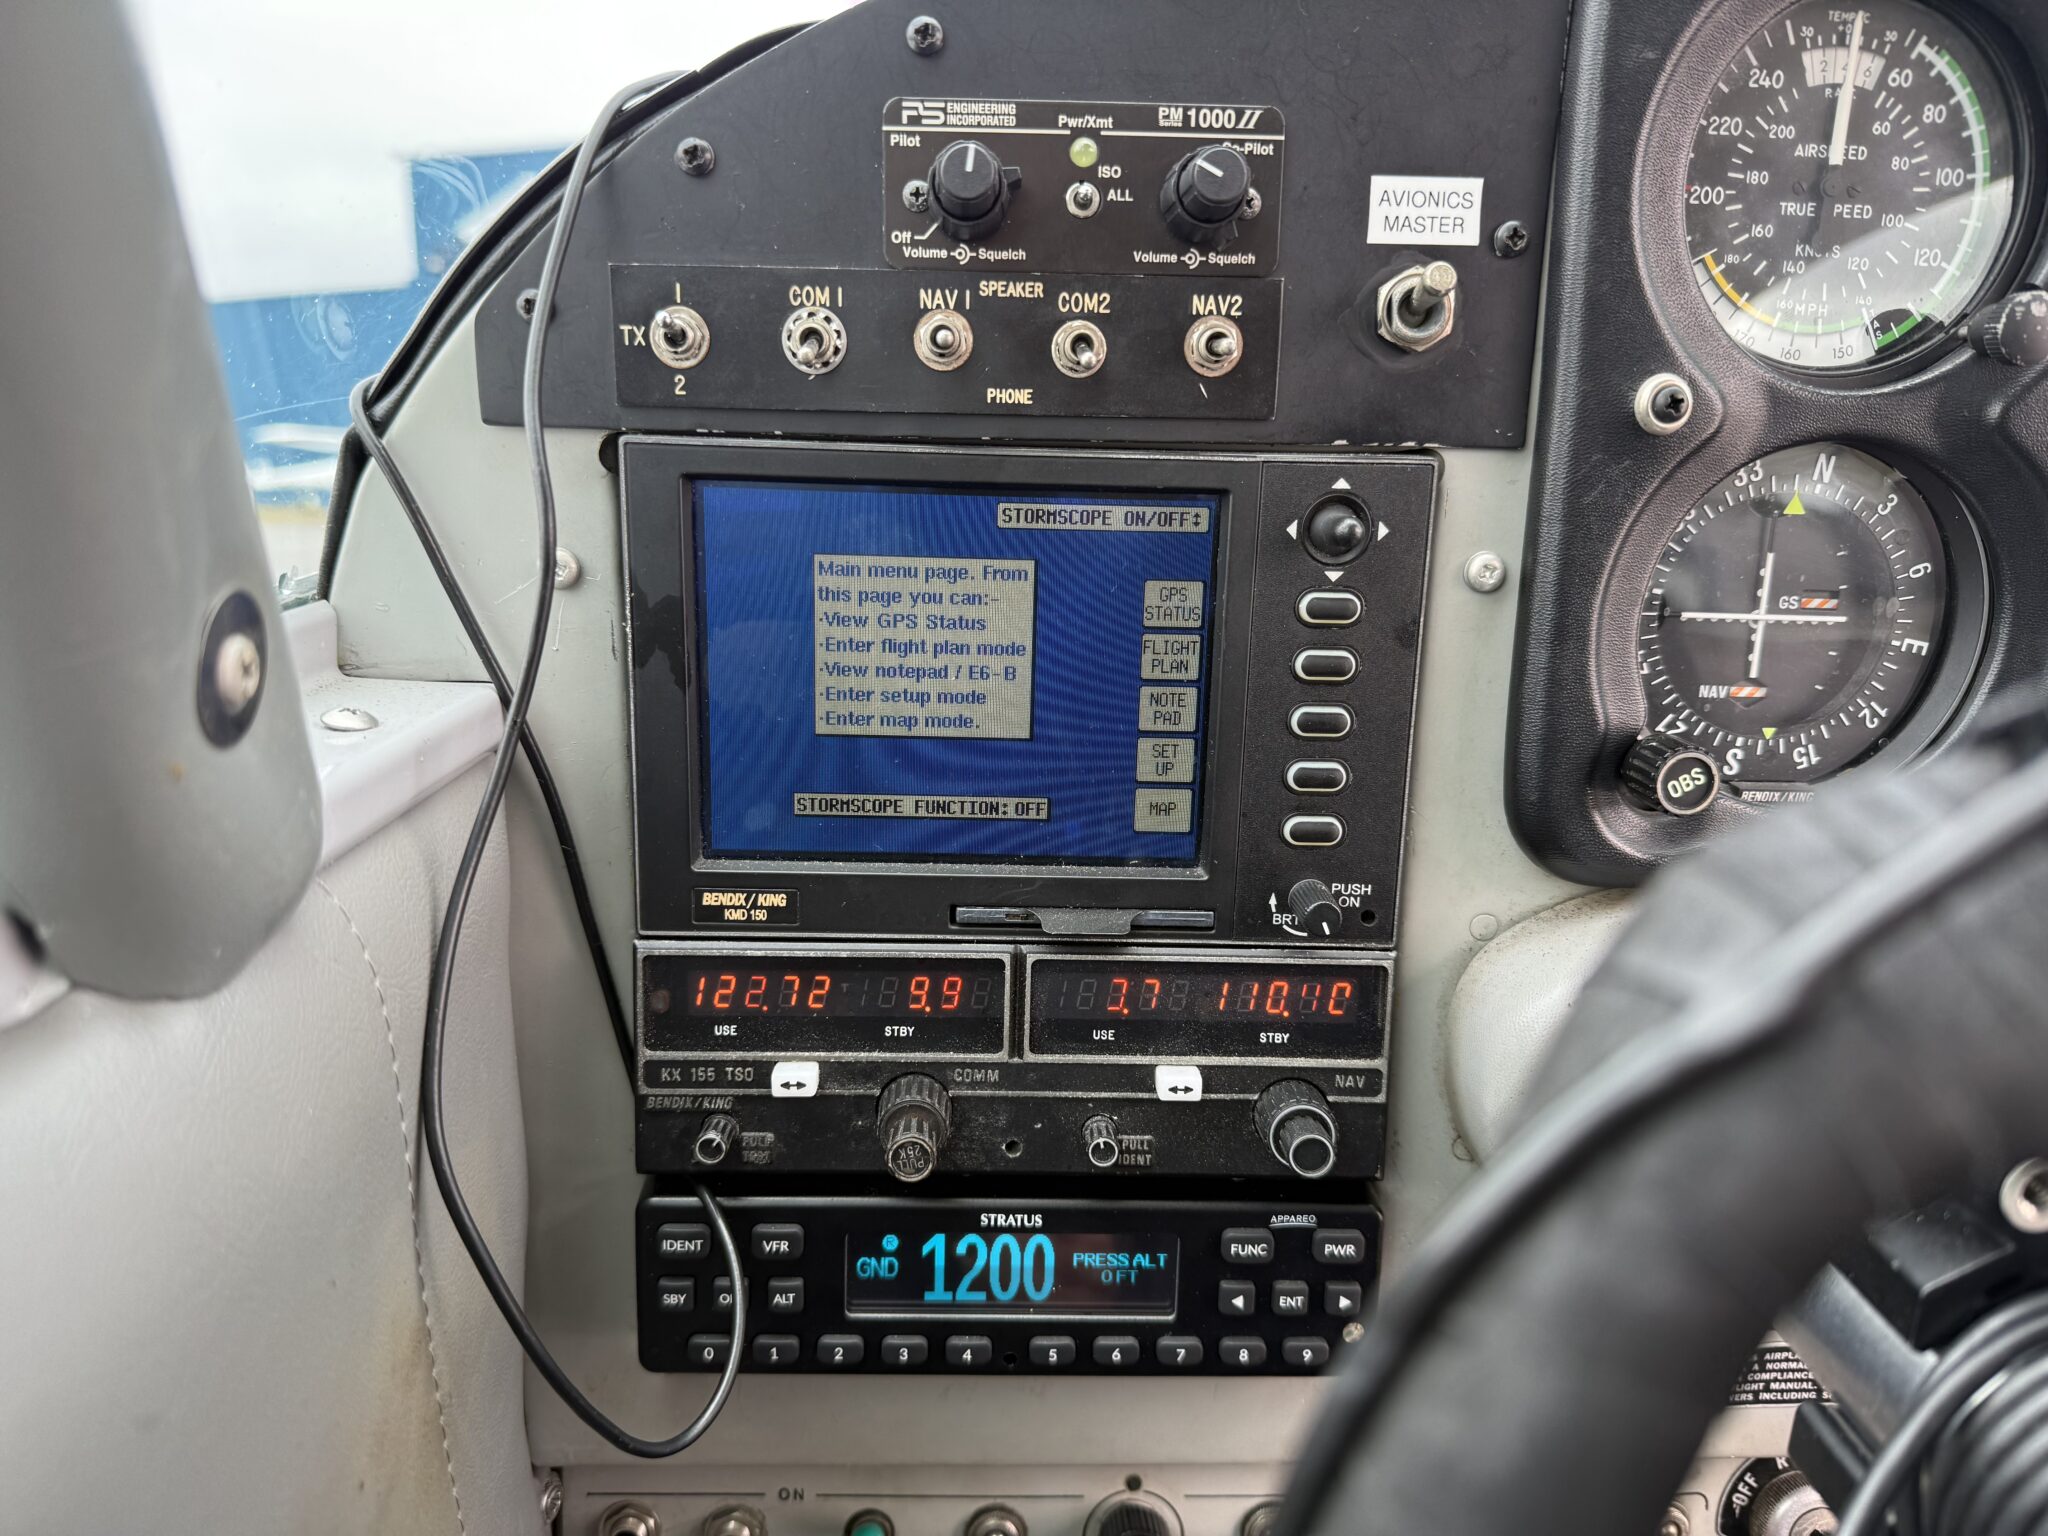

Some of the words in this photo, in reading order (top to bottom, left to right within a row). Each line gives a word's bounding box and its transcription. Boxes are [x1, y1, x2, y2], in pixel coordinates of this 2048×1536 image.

[1800, 26, 1814, 37] 30
[1883, 30, 1898, 42] 30
[1820, 60, 1828, 73] 2
[1863, 66, 1872, 79] 6
[1748, 68, 1784, 90] 240
[1887, 68, 1913, 88] 60
[902, 101, 945, 125] PS
[946, 102, 1016, 115] ENGINEERING
[1922, 104, 1947, 123] 80
[946, 114, 1016, 127] INCORPORATED
[1058, 114, 1114, 129] Pwr/Xmt
[1158, 107, 1183, 121] PM
[1186, 109, 1236, 129] 1000
[1158, 120, 1183, 128] Series
[1708, 116, 1743, 136] 220
[1768, 125, 1796, 139] 200
[1872, 121, 1891, 136] 60
[890, 134, 921, 148] Pilot
[1891, 156, 1910, 171] 80
[1098, 166, 1121, 178] ISO
[1746, 170, 1769, 185] 180
[1935, 168, 1965, 187] 100
[1107, 189, 1134, 202] ALL
[1378, 189, 1474, 210] AVIONICS
[1689, 186, 1725, 205] 200
[1780, 202, 1817, 217] TRUE
[1383, 215, 1465, 234] MASTER
[1881, 214, 1904, 228] 100
[890, 231, 913, 244] Off
[1751, 224, 1774, 239] 160
[902, 246, 948, 260] Volume
[978, 249, 1027, 263] Squelch
[1133, 251, 1178, 265] Volume
[1207, 252, 1256, 266] Squelch
[1724, 254, 1740, 265] 180
[1914, 247, 1941, 267] 120
[1783, 260, 1805, 274] 140
[1847, 256, 1869, 271] 120
[979, 281, 1044, 298] SPEAKER
[1058, 292, 1111, 314] COM2
[1192, 294, 1243, 316] NAV2
[1855, 295, 1873, 306] 140
[1776, 301, 1793, 310] 160
[1794, 303, 1828, 317] MPH
[620, 324, 647, 346] TX
[1780, 346, 1801, 361] 160
[1832, 345, 1854, 360] 150
[674, 374, 687, 395] 2
[986, 388, 1033, 404] PHONE
[1812, 452, 1836, 484] N
[1877, 494, 1897, 516] 3
[1001, 507, 1112, 527] STORMSCOPE
[1123, 510, 1190, 527] ON/OFF
[818, 560, 861, 578] Main
[868, 565, 919, 579] menu
[925, 566, 976, 584] page.
[983, 564, 1029, 582] From
[817, 586, 852, 603] this
[858, 591, 902, 608] page
[909, 591, 943, 608] you
[1159, 587, 1188, 603] GPS
[1778, 596, 1799, 610] GS
[1144, 606, 1201, 622] STATUS
[877, 613, 918, 629] GPS
[926, 615, 987, 631] Status
[881, 639, 928, 659] flight
[933, 640, 971, 659] plan
[976, 642, 1027, 657] mode
[1143, 640, 1199, 656] FLIGHT
[1901, 637, 1929, 656] E
[875, 664, 949, 683] notepad
[1151, 658, 1189, 674] PLAN
[881, 688, 931, 708] setup
[937, 690, 987, 705] mode
[1698, 684, 1729, 699] NAV
[1150, 692, 1187, 708] NOTE
[1153, 710, 1182, 726] PAD
[1857, 700, 1888, 729] 12
[880, 714, 919, 732] map
[924, 714, 981, 729] mode.
[1152, 744, 1179, 759] SET
[1792, 743, 1821, 770] 15
[1155, 762, 1174, 777] UP
[1722, 748, 1744, 776] S
[1667, 767, 1706, 799] OBS
[797, 797, 904, 813] STORMSCOPE
[914, 799, 1008, 816] FUNCTION:
[1014, 801, 1047, 816] OFF
[1149, 801, 1177, 817] MAP
[1331, 883, 1372, 895] PUSH
[1338, 896, 1360, 908] ON
[724, 909, 747, 920] KMD
[750, 909, 767, 921] 150
[714, 1024, 738, 1036] USE
[884, 1025, 915, 1037] STBY
[1093, 1029, 1115, 1040] USE
[1259, 1032, 1290, 1044] STBY
[661, 1067, 682, 1082] KX
[691, 1066, 716, 1081] 155
[724, 1066, 754, 1082] TSO
[953, 1068, 1000, 1083] COMM
[1335, 1074, 1366, 1090] NAV
[1122, 1139, 1149, 1150] PULL
[980, 1213, 1043, 1228] STRATUS
[1270, 1214, 1316, 1224] APPAREO
[663, 1239, 703, 1252] IDENT
[763, 1240, 789, 1253] VFR
[1230, 1243, 1268, 1256] FUNC
[1324, 1244, 1355, 1257] PWR
[857, 1256, 899, 1280] GND
[922, 1233, 1055, 1303] 1200
[1072, 1252, 1130, 1269] PRESS
[1132, 1253, 1168, 1269] ALT
[663, 1293, 687, 1304] SBY
[773, 1292, 795, 1304] ALT
[1279, 1295, 1303, 1308] ENT
[704, 1347, 714, 1360] 0
[770, 1347, 778, 1360] 1
[834, 1347, 843, 1360] 2
[899, 1348, 908, 1361] 3
[962, 1349, 971, 1362] 4
[1049, 1349, 1057, 1362] 5
[1112, 1348, 1121, 1361] 6
[1176, 1349, 1185, 1362] 7
[1239, 1349, 1248, 1362] 8
[1302, 1349, 1312, 1362] 9
[1747, 1372, 1815, 1381] COMPLIANCE
[1735, 1382, 1765, 1391] LIGHT
[1769, 1382, 1817, 1390] MANUAL.
[1758, 1392, 1816, 1400] INCLUDING
[778, 1487, 804, 1500] ON
[1732, 1472, 1759, 1506] OFF
